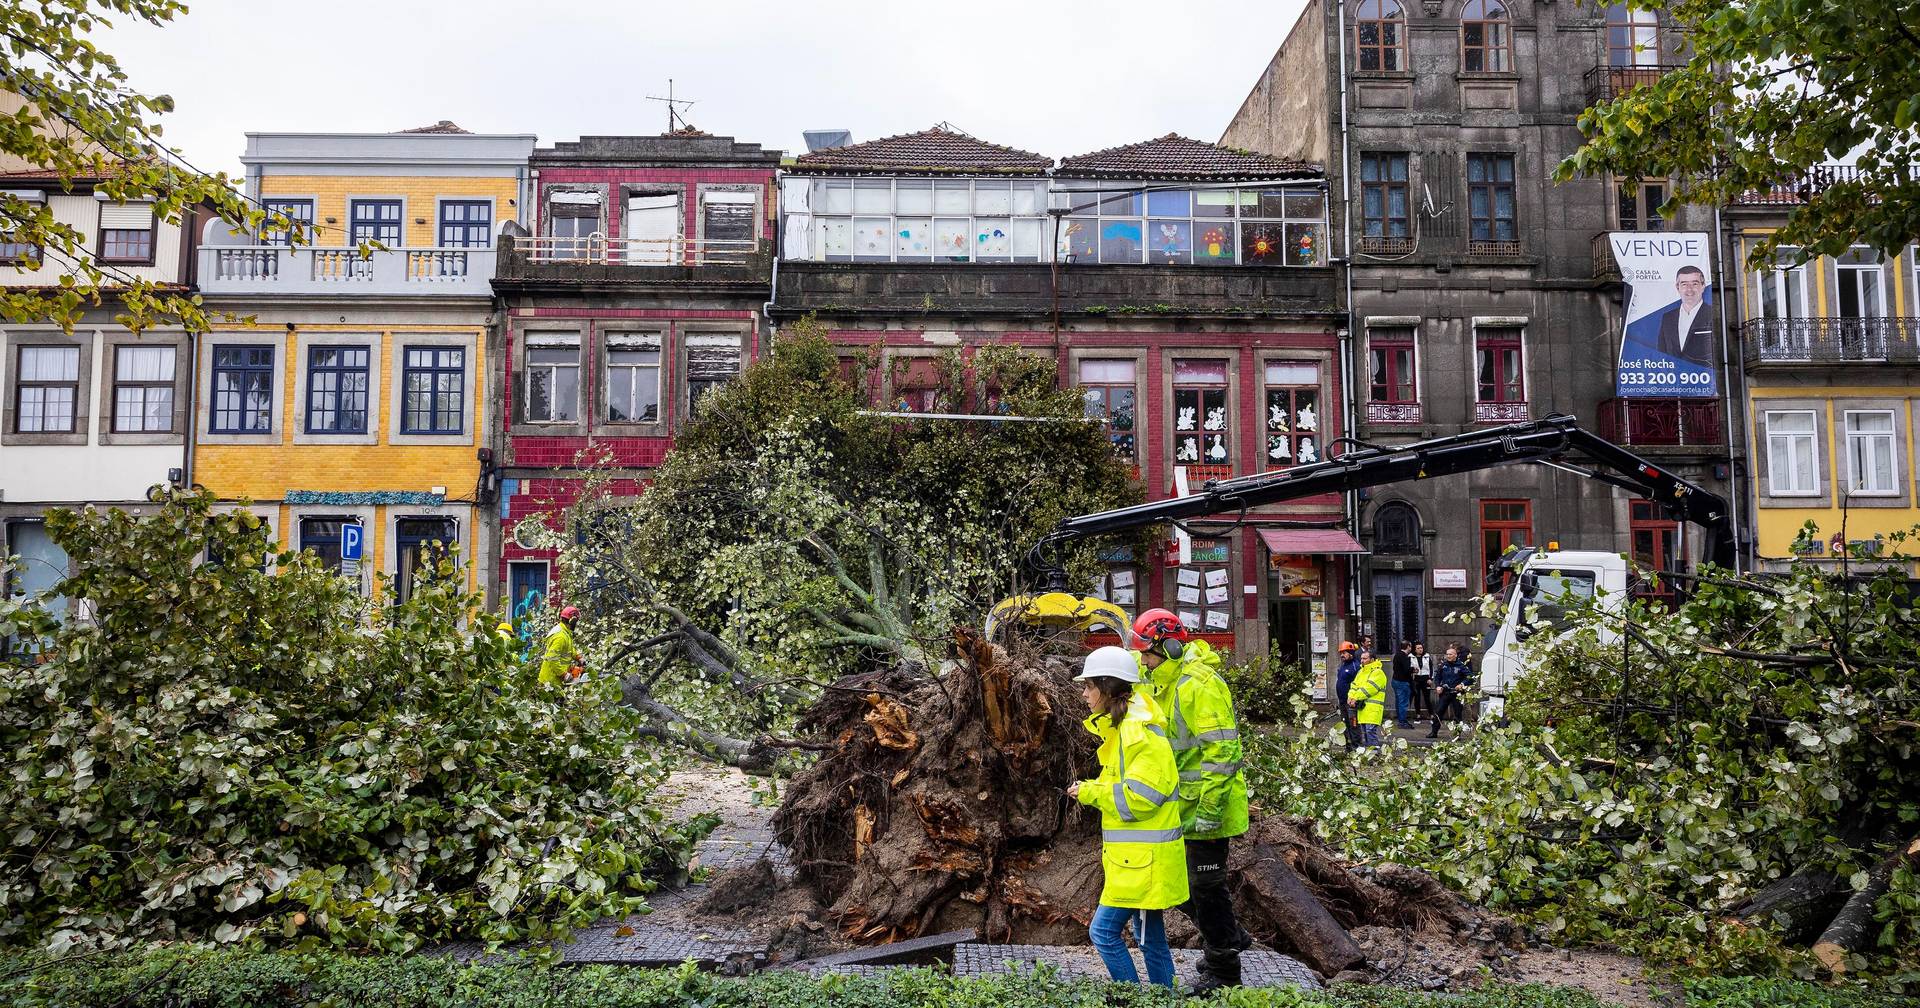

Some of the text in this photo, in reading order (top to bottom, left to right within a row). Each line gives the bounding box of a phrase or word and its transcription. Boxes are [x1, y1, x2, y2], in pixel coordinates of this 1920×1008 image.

[1616, 240, 1699, 256] VENDE
[1619, 358, 1675, 369] José Rocha
[1620, 372, 1711, 385] 933 200 900
[347, 528, 359, 556] P
[1214, 547, 1226, 555] DE
[1197, 863, 1220, 872] STIHL
